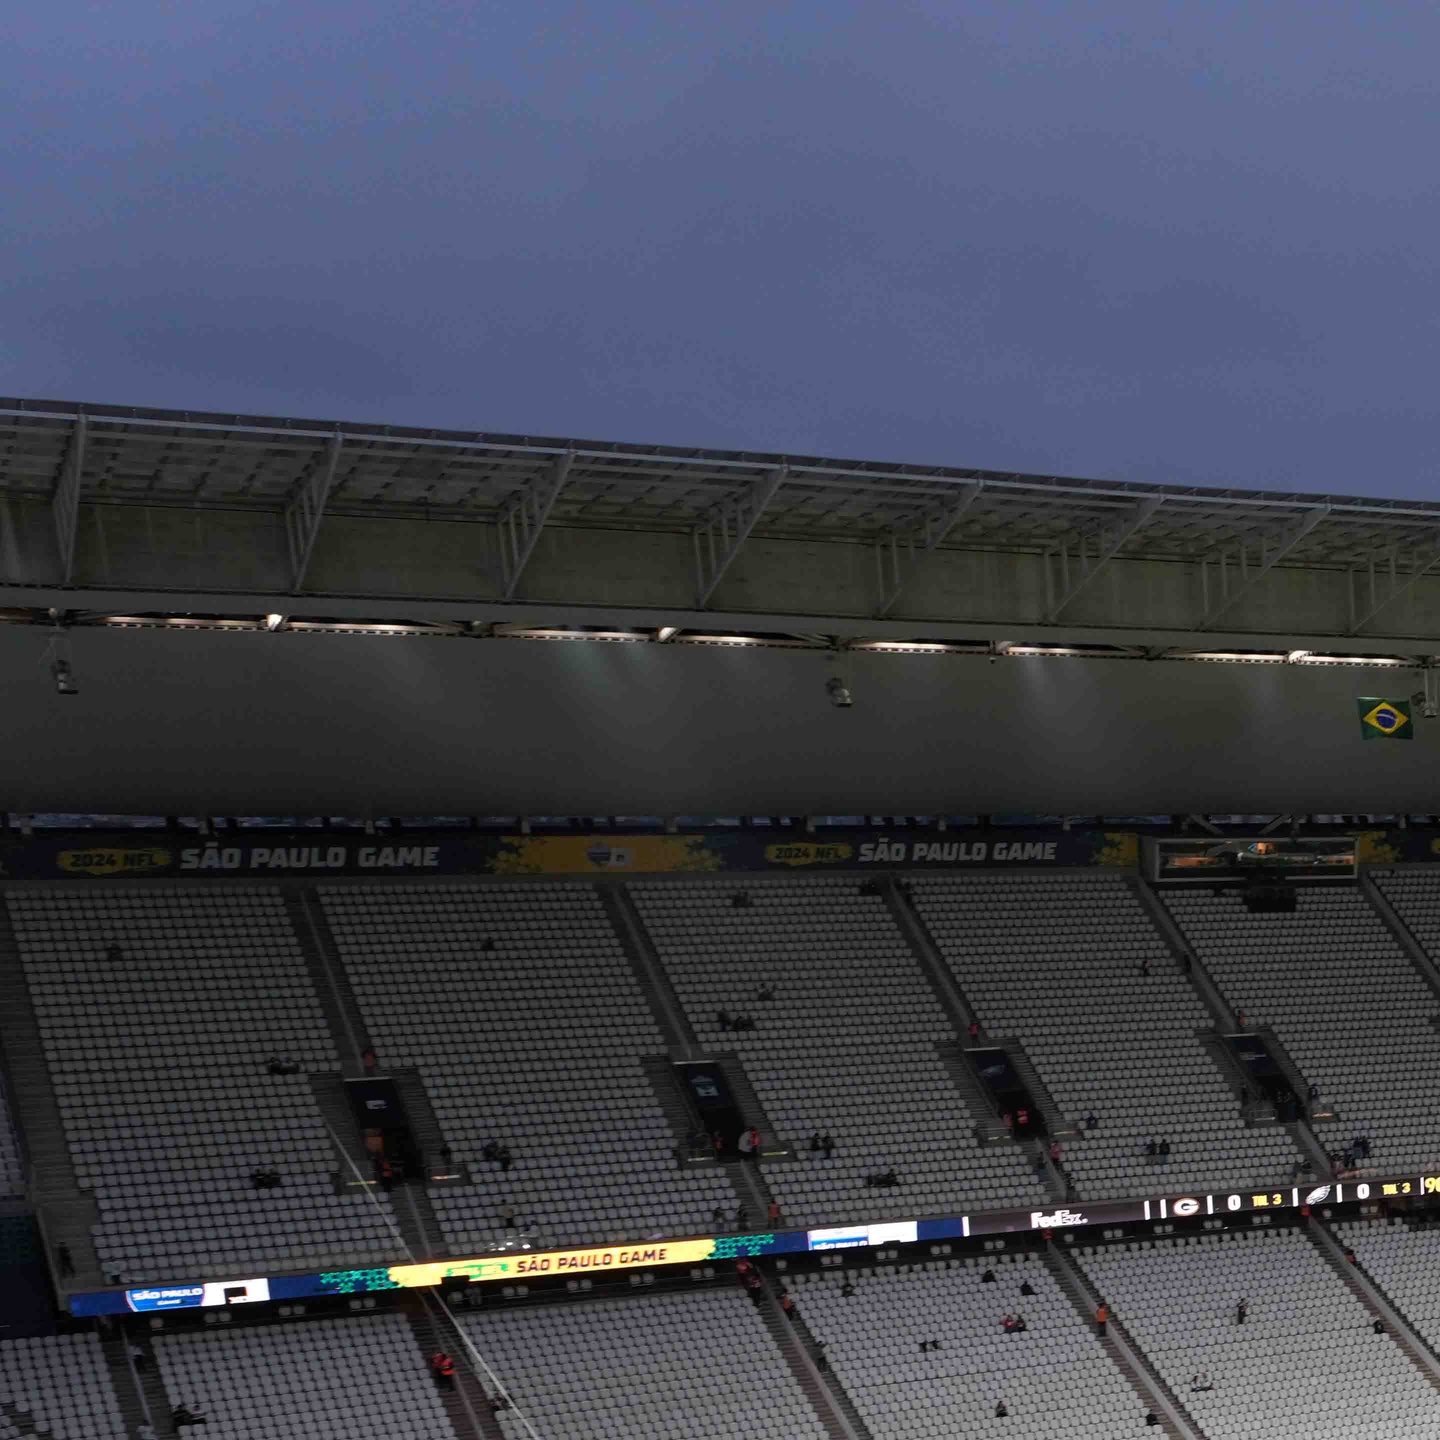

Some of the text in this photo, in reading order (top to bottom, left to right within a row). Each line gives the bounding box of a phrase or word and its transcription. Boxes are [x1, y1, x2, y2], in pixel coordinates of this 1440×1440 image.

[180, 842, 440, 869] SÃO PAULO GAME
[774, 847, 841, 859] 2024 NFL
[858, 838, 1058, 862] SÃO PAULO GAME
[70, 852, 158, 867] 2024 NFL
[1357, 1183, 1370, 1199] 0
[1402, 1182, 1411, 1194] 3
[1227, 1194, 1241, 1211] 0
[1273, 1193, 1282, 1205] 3
[517, 1258, 549, 1273] SÃO
[557, 1254, 612, 1270] PAULO
[619, 1248, 667, 1264] GAME
[132, 1287, 203, 1301] SÃO PAULO
